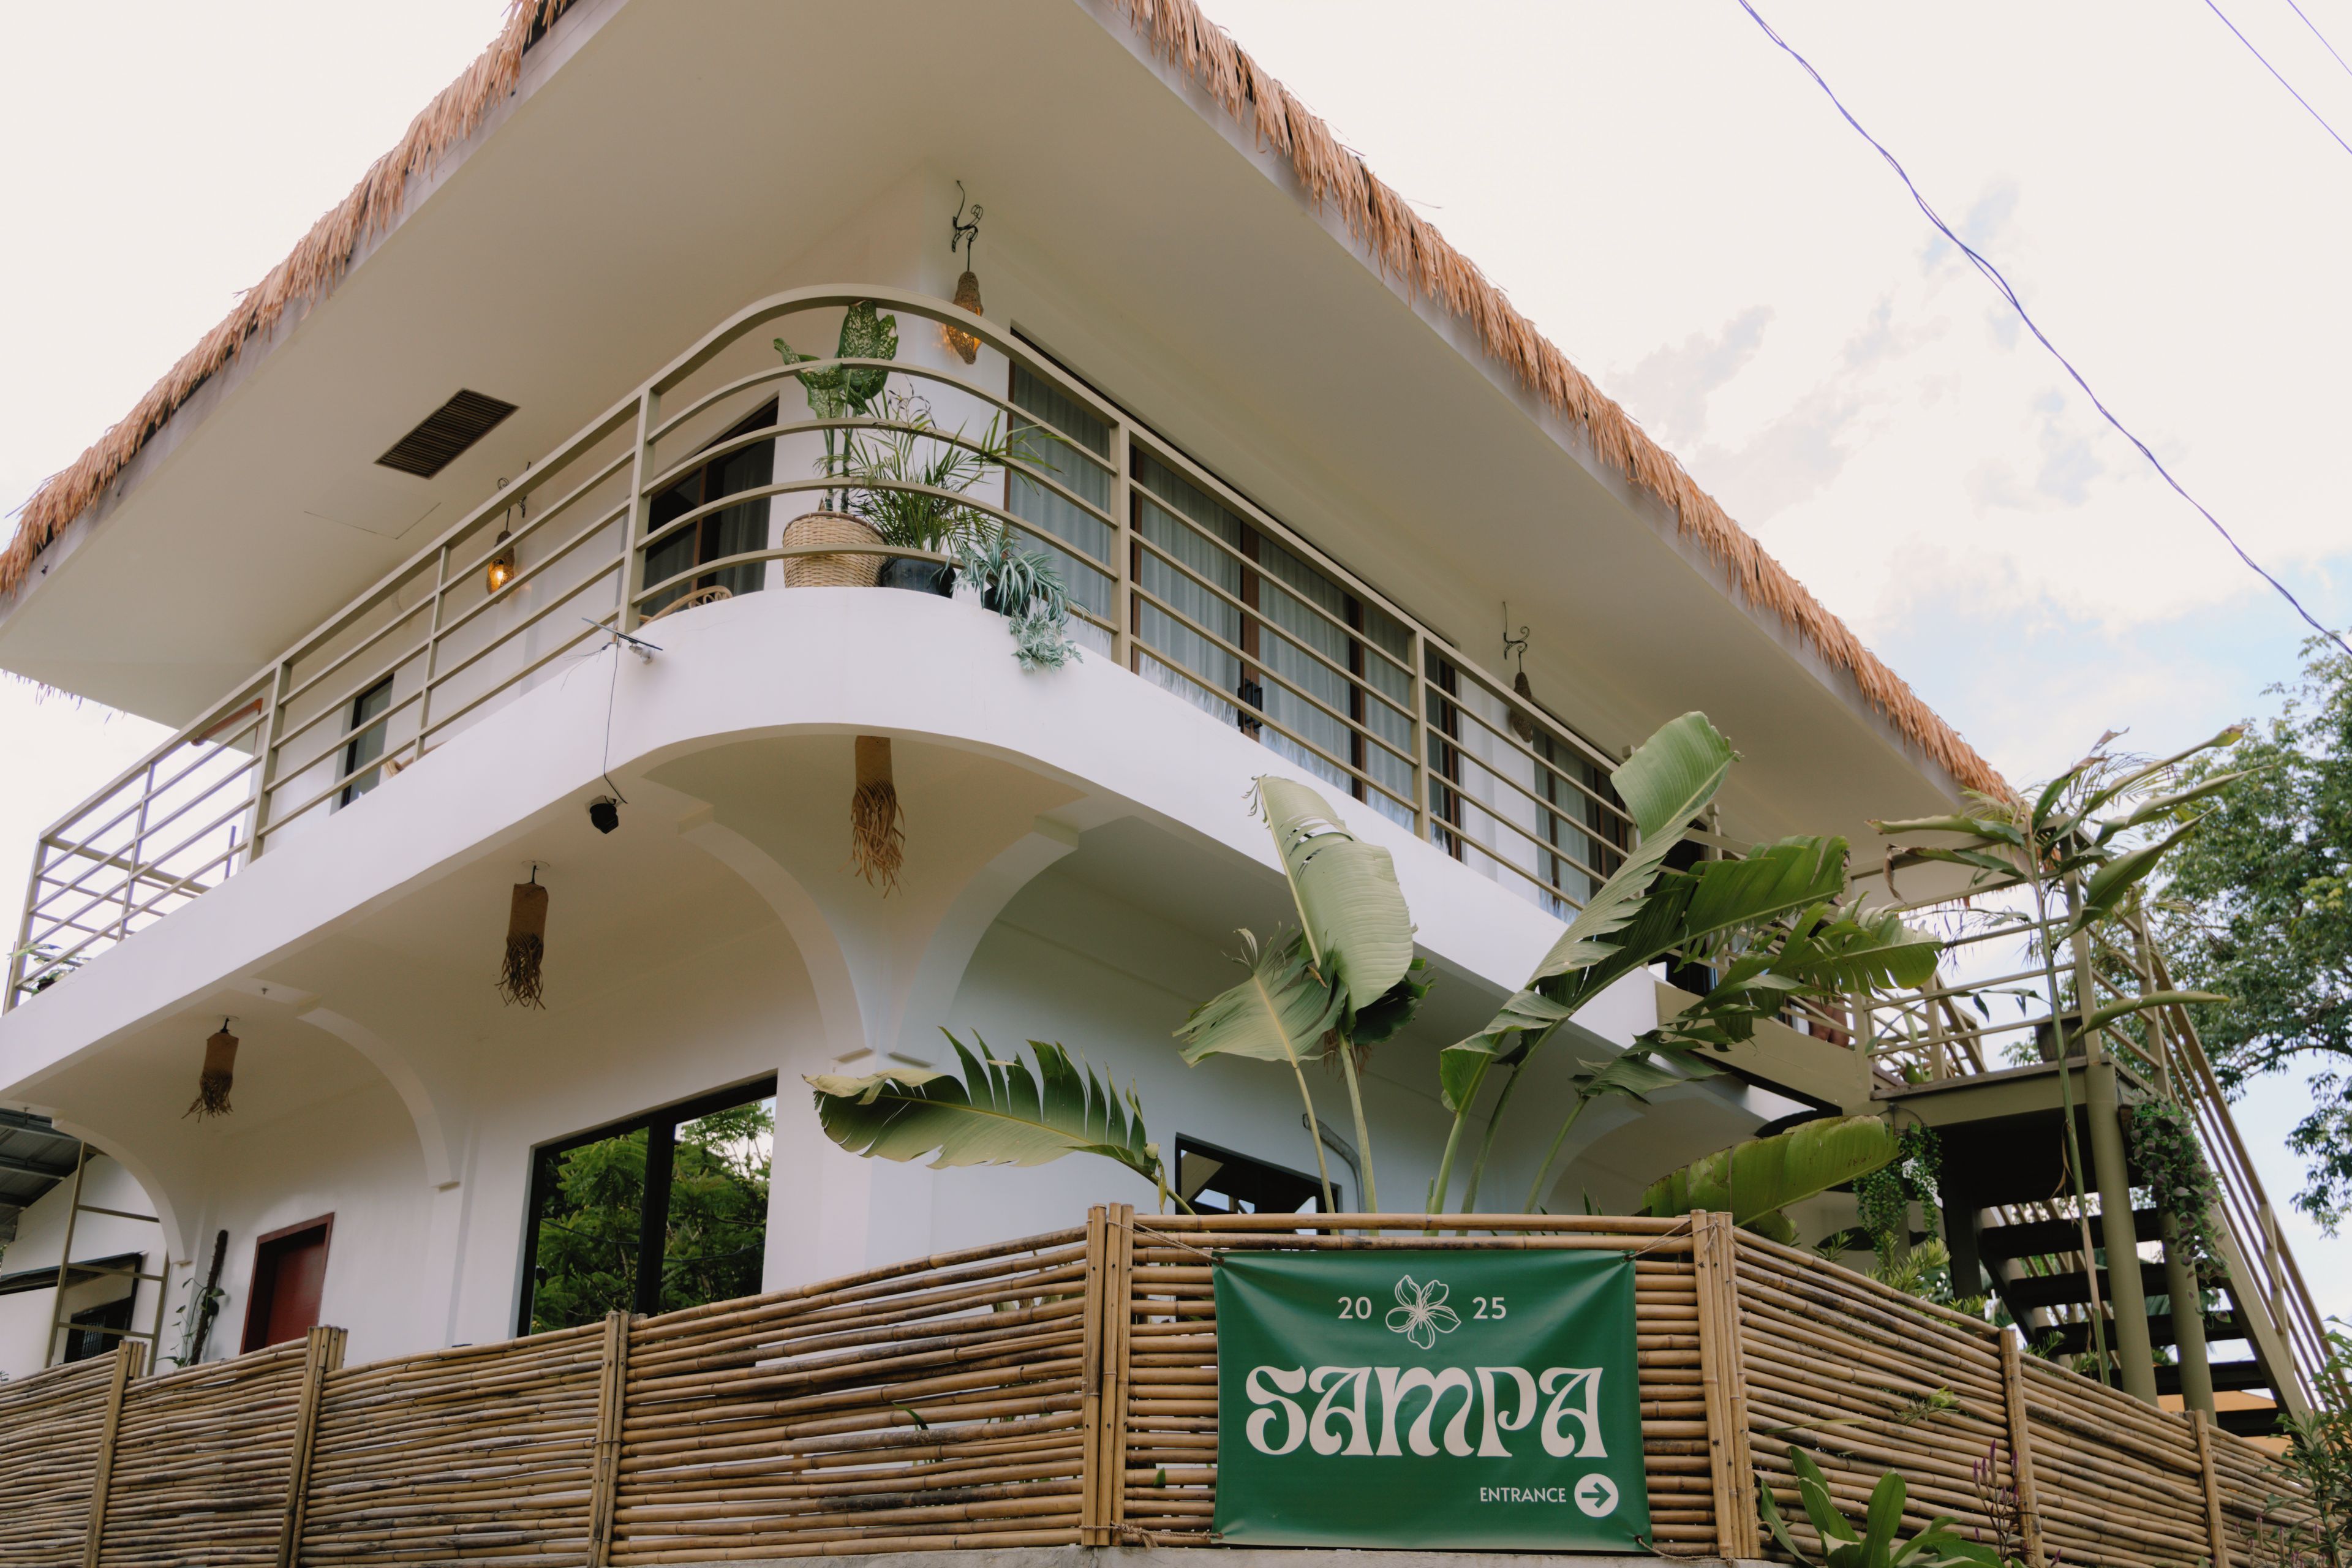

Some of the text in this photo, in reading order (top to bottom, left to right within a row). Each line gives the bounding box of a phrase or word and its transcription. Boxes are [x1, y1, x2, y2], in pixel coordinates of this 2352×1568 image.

[1338, 1297, 1506, 1319] 20 25
[1245, 1365, 1608, 1458] SAMPA
[1480, 1487, 1567, 1502] ENTRANCE
